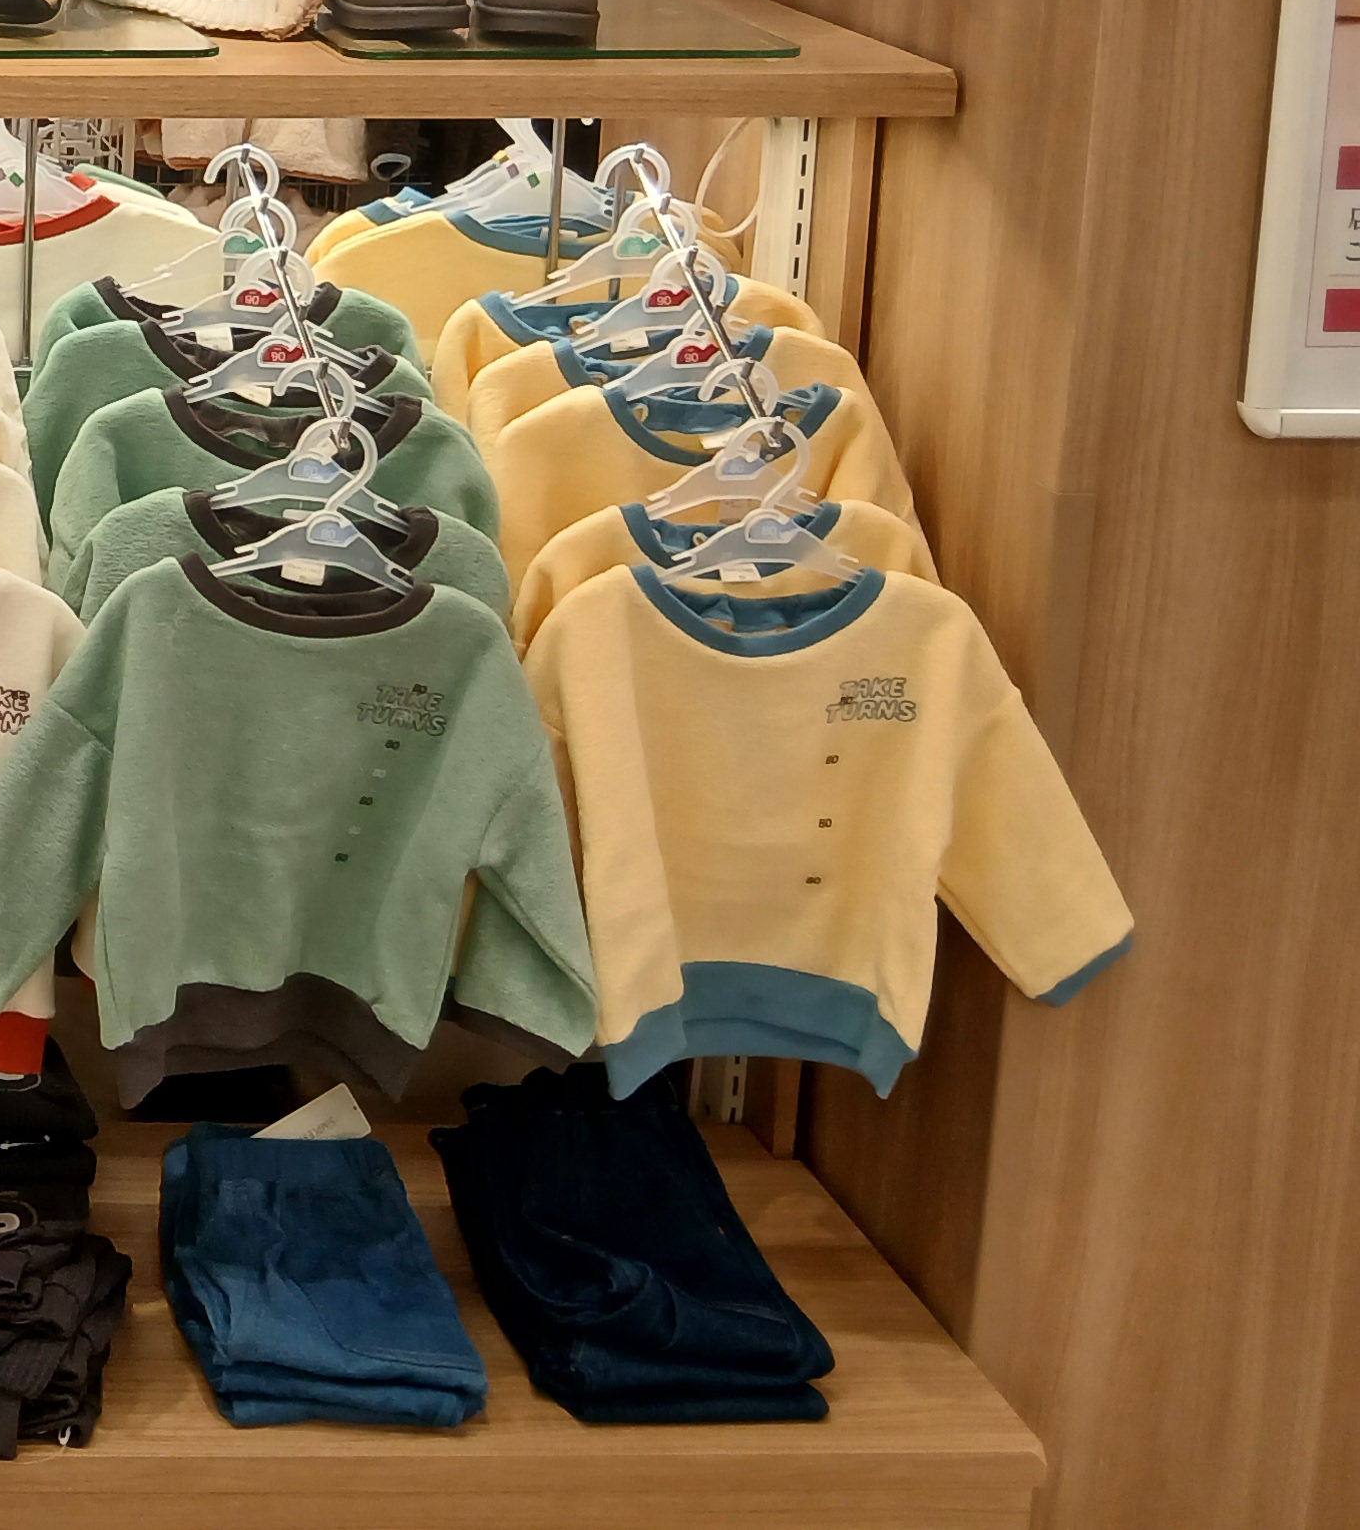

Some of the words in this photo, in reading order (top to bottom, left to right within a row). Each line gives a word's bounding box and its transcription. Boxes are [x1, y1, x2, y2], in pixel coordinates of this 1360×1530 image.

[245, 295, 259, 305] 90
[657, 296, 671, 306] 90
[270, 351, 285, 362] 90
[684, 352, 699, 362] 90
[839, 676, 907, 699] TAKE
[376, 684, 445, 712] TAKE
[356, 702, 447, 736] TURNS
[825, 699, 917, 724] TURNS
